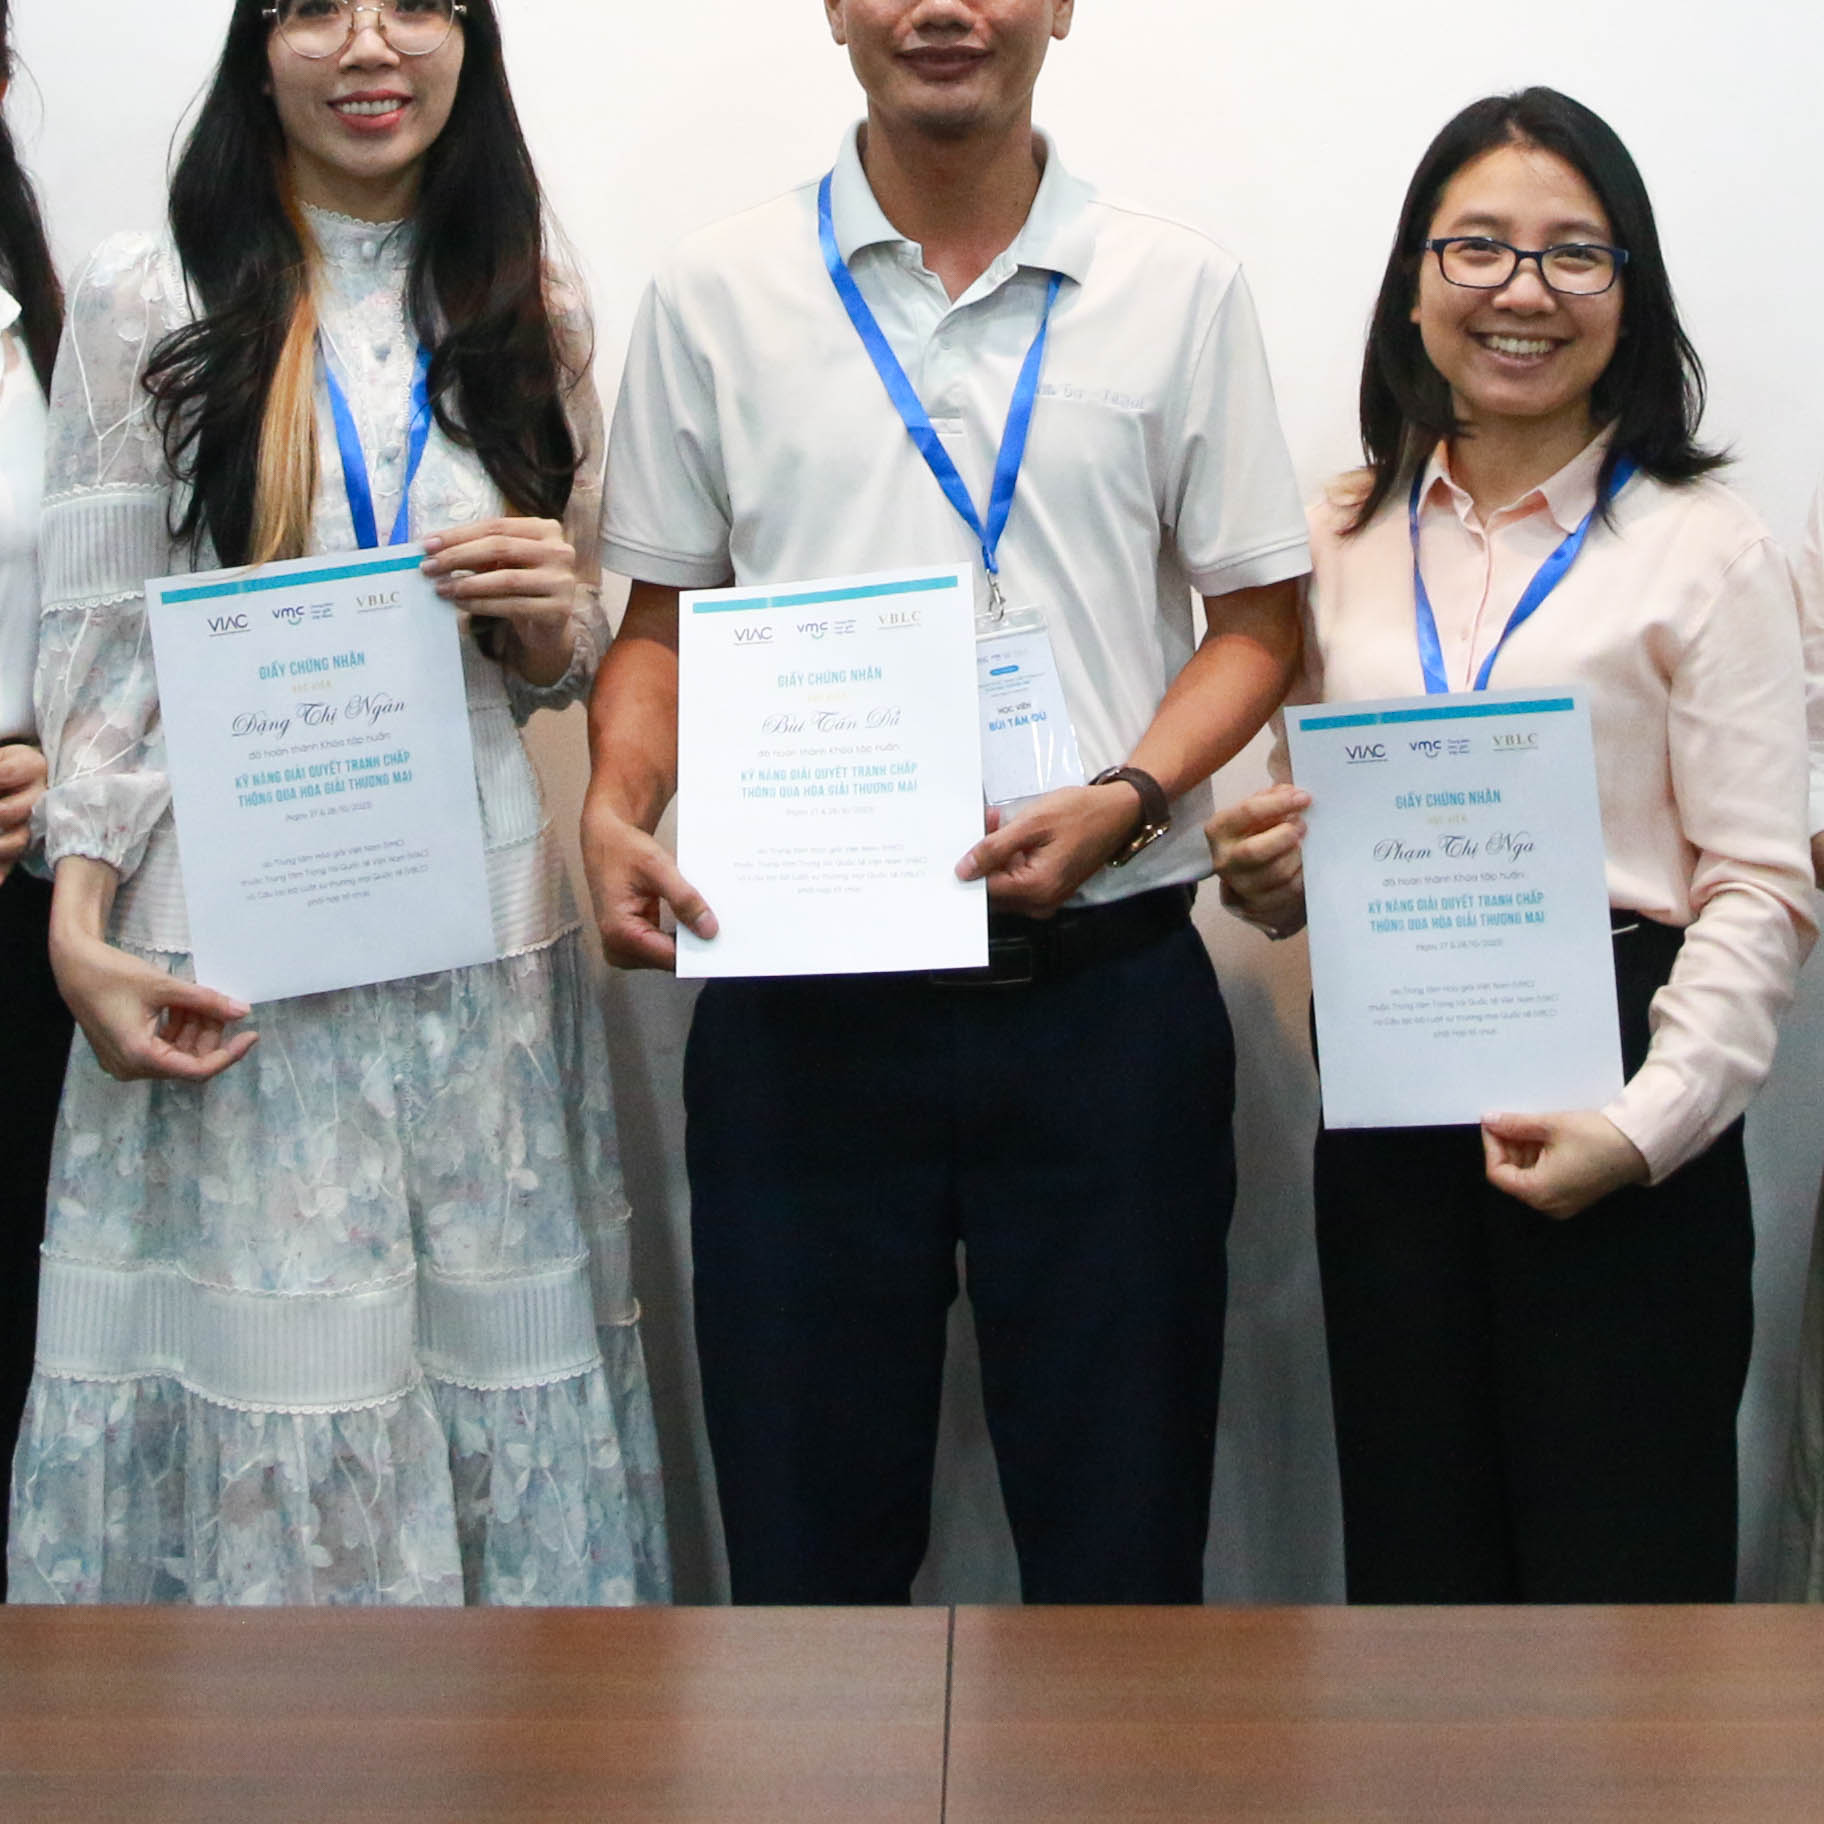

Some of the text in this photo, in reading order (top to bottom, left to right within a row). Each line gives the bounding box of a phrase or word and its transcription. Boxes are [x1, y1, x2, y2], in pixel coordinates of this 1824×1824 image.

[208, 614, 248, 631] VIAC
[734, 626, 773, 641] VIAC
[1345, 743, 1386, 759] VIAC
